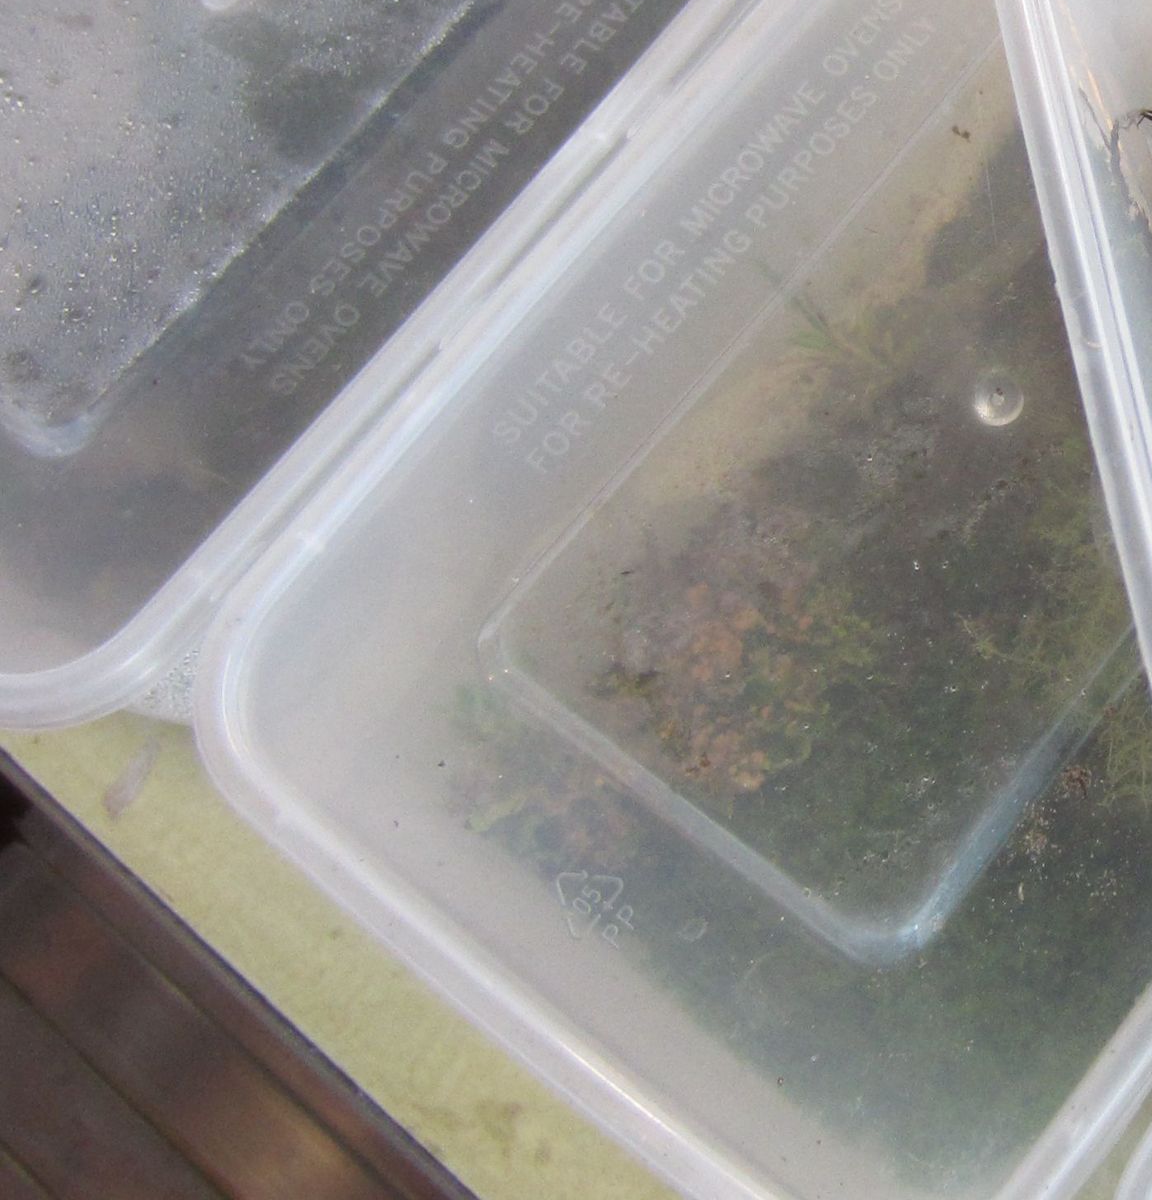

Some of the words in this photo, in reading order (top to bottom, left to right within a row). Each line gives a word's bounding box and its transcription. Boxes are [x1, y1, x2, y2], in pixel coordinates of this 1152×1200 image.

[505, 77, 564, 137] FOR
[308, 149, 447, 298] PURPOSES
[366, 138, 513, 298] MICROWAVE
[492, 302, 627, 445] SUITABLE
[623, 238, 686, 302] FOR
[680, 79, 827, 241] MICROWAVE
[526, 409, 591, 476] FOR
[583, 227, 753, 411] RE-HEATING
[744, 84, 879, 230] PURPOSES
[872, 15, 937, 82] ONLY
[237, 298, 312, 372] ONLY
[268, 302, 361, 395] OVENS
[602, 904, 635, 949] PP
